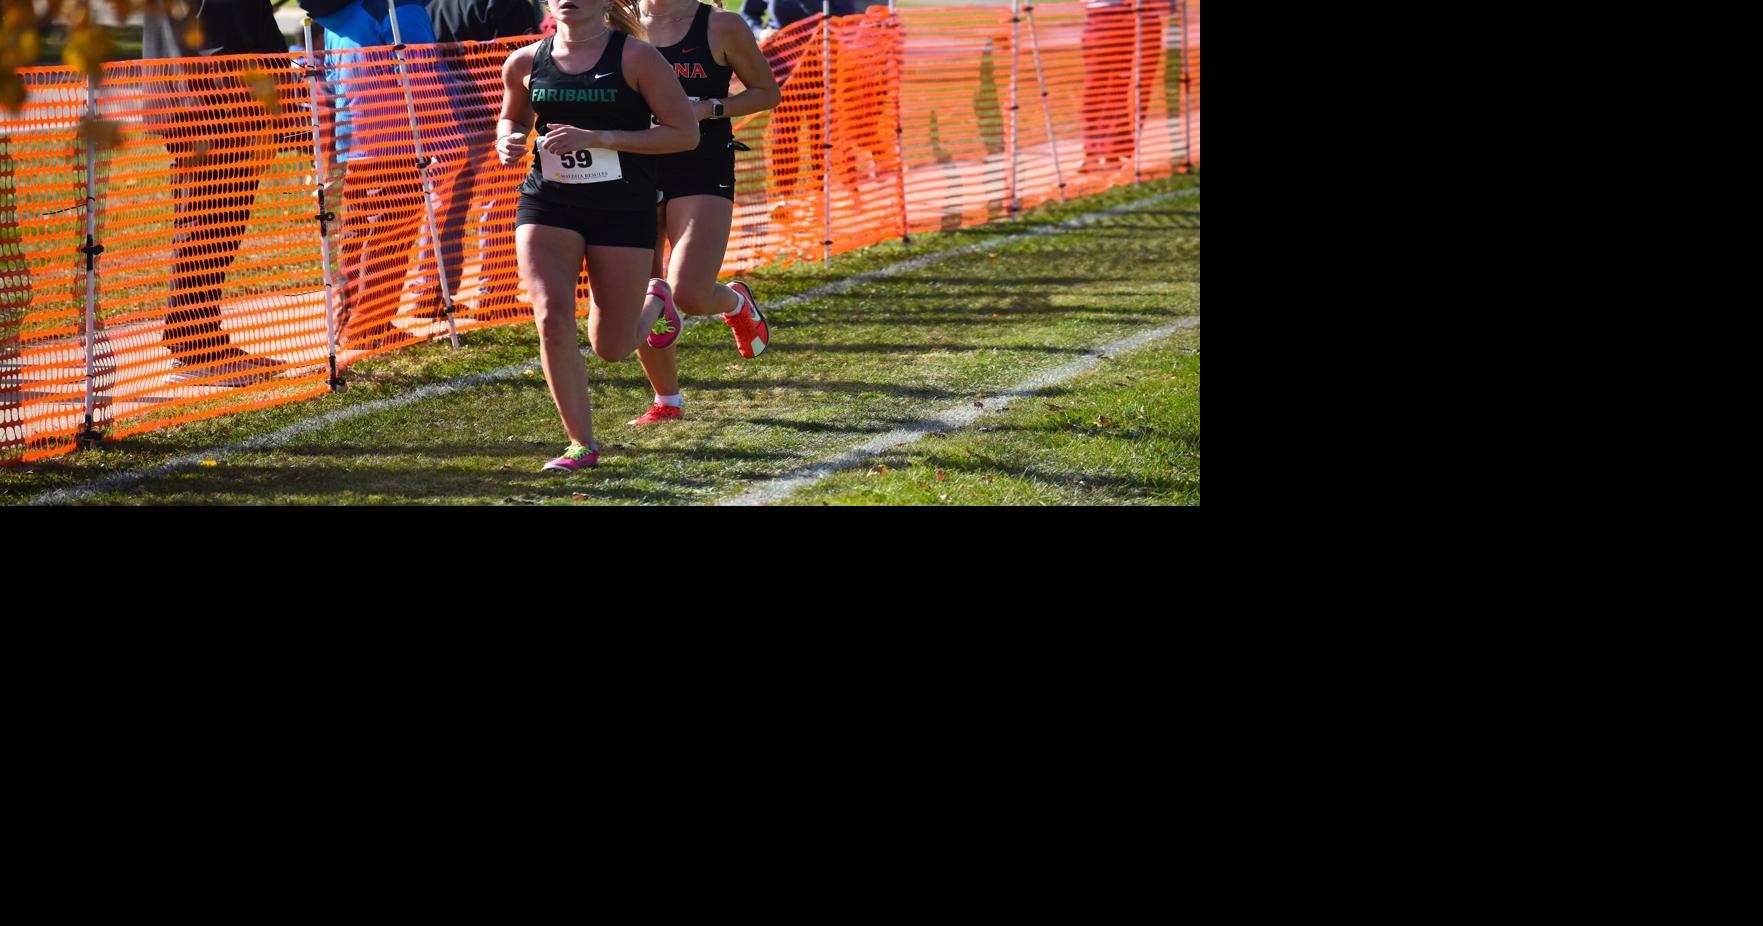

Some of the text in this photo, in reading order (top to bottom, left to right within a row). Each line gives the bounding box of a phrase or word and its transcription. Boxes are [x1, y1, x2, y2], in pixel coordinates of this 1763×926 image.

[672, 63, 707, 79] NA
[531, 88, 618, 102] FARIBAULT
[560, 149, 593, 169] 59
